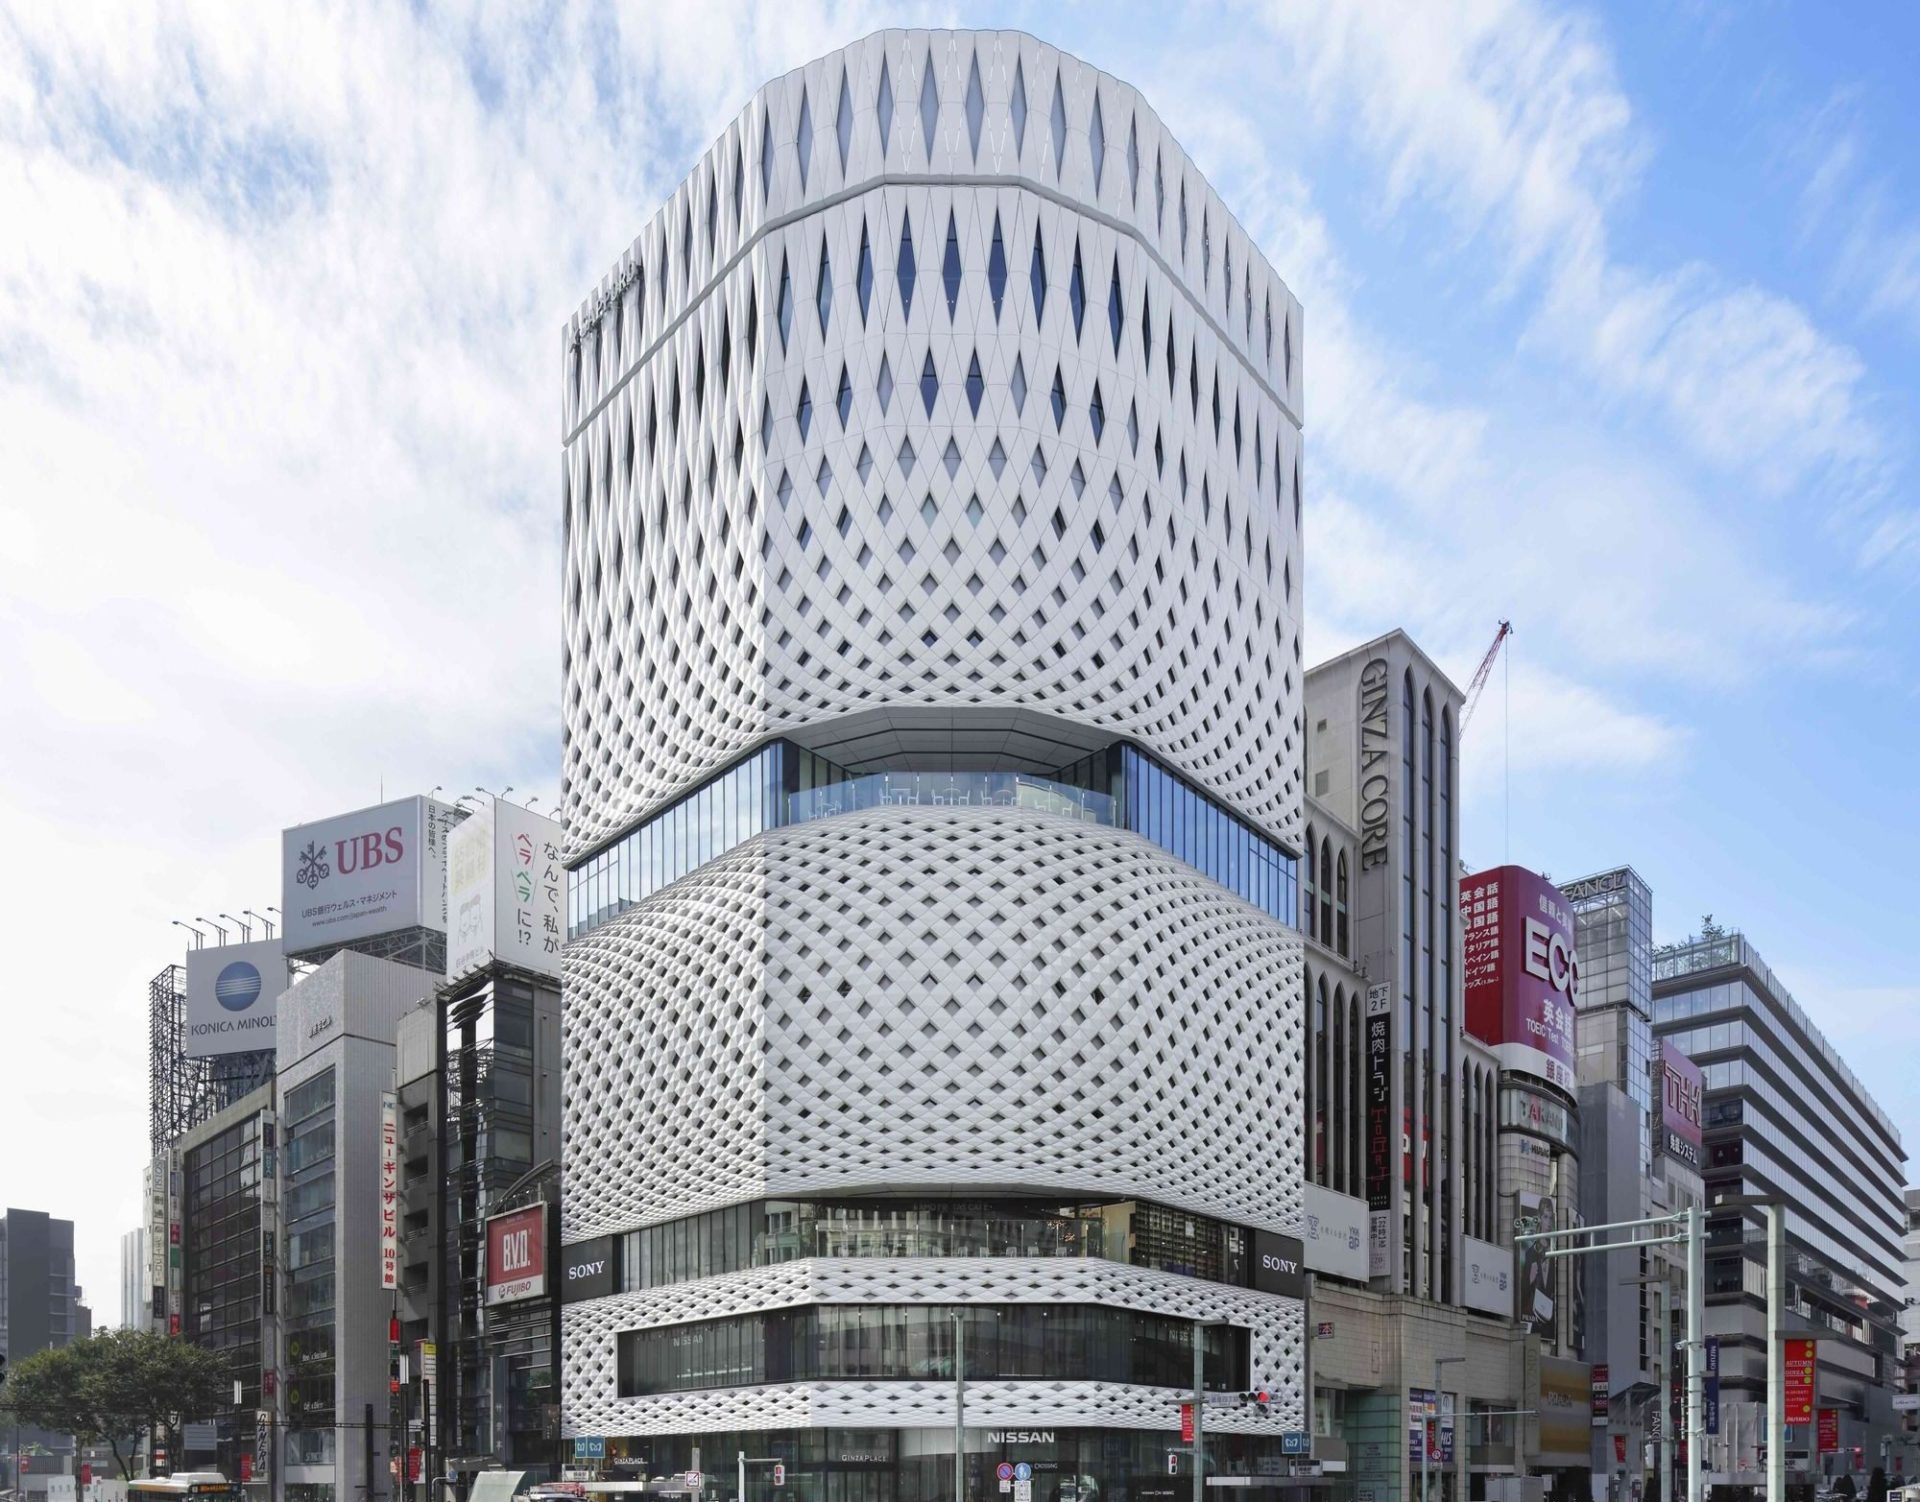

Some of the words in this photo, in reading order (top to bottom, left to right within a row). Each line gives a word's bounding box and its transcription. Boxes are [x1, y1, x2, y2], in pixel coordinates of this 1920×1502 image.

[1361, 658, 1389, 774] GINZA
[1361, 775, 1389, 872] CORE
[334, 826, 404, 875] UBS
[543, 841, 560, 954] なんで、私が
[1460, 882, 1499, 904] 英会話
[1563, 873, 1628, 901] FANCL
[1526, 915, 1580, 1007] ECC
[1368, 986, 1389, 999] 地下
[1371, 998, 1388, 1011] 2F
[191, 1019, 235, 1037] KONICA
[237, 1014, 277, 1031] MINOL
[1526, 1017, 1546, 1037] TOEIC
[1371, 1020, 1389, 1102] 焼肉トラジ
[1663, 1060, 1702, 1129] THK
[383, 1122, 397, 1238] ニューギンザビル
[503, 1230, 530, 1272] B.V.D.
[568, 1260, 605, 1280] SONY
[1262, 1254, 1297, 1275] SONY
[506, 1280, 532, 1297] FUJIBO
[987, 1431, 1055, 1444] NISSAN
[842, 1454, 864, 1462] GINZA
